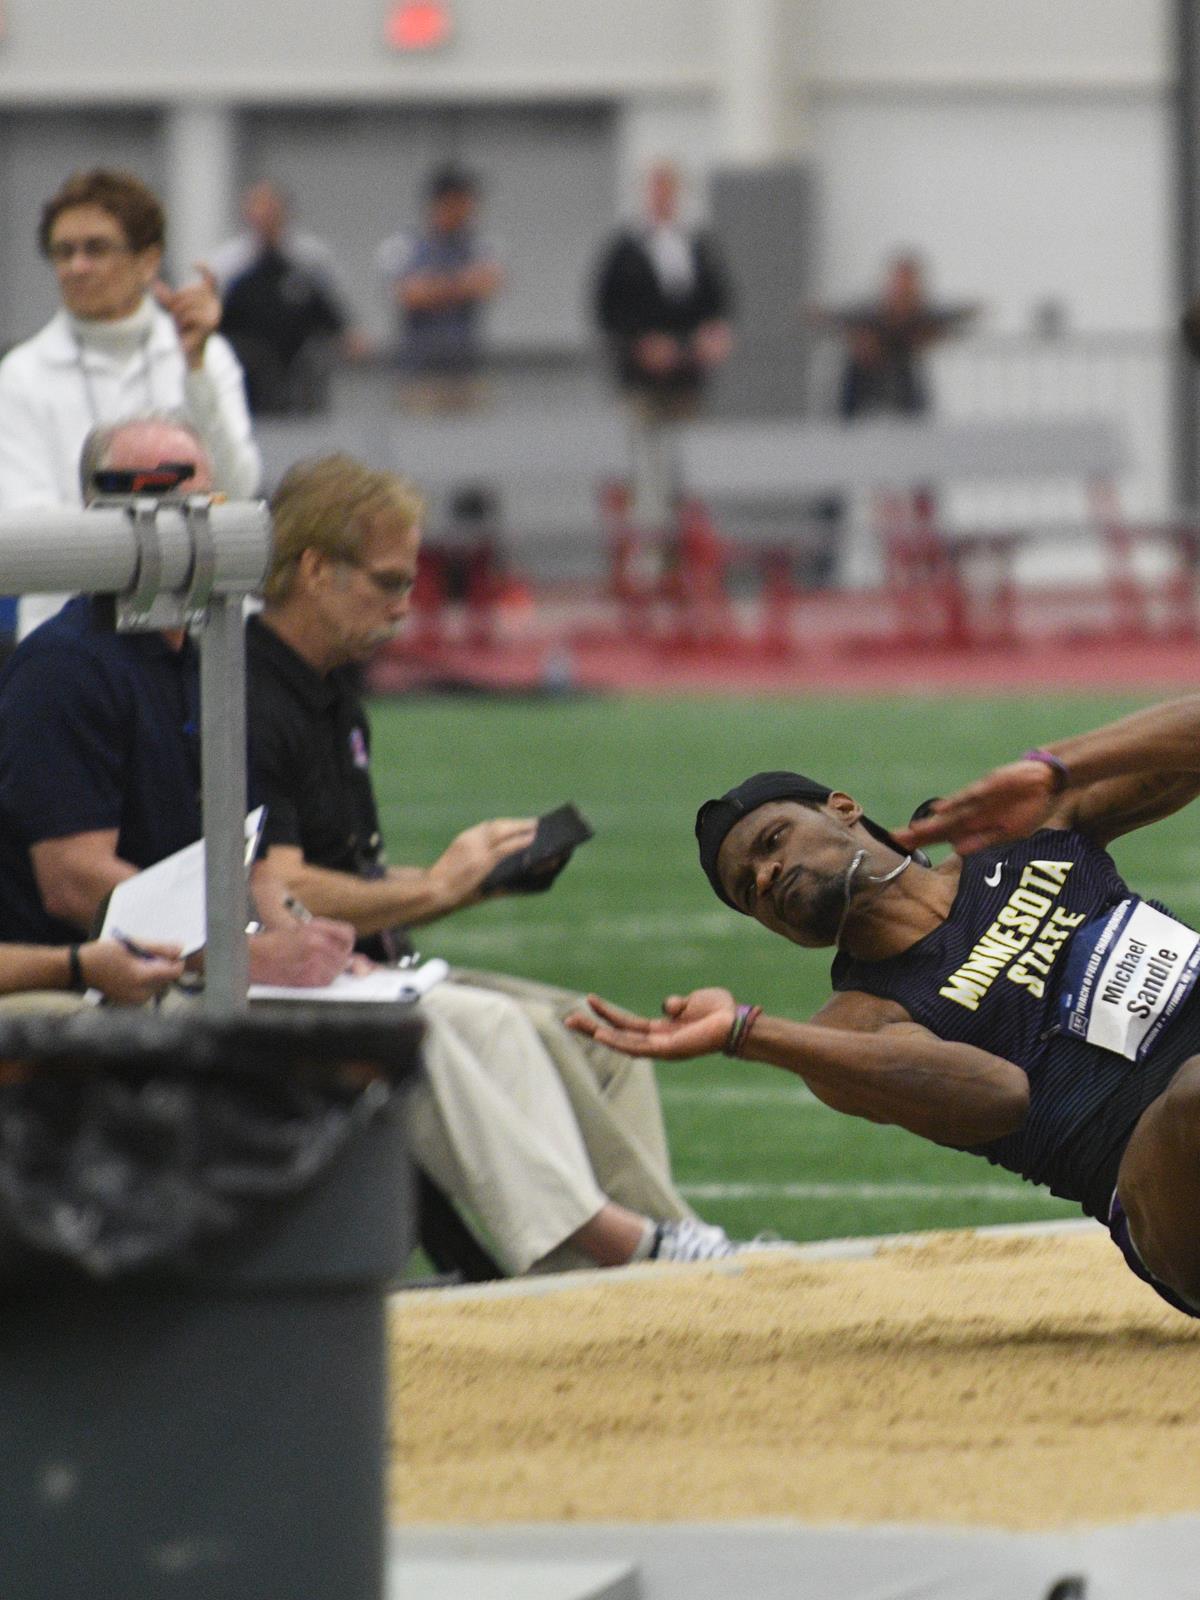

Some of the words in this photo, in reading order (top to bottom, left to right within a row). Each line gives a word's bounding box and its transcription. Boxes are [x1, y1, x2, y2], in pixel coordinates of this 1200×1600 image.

[939, 860, 1074, 1011] MINNESOTA
[1007, 906, 1086, 998] STATE
[1076, 985, 1091, 1014] TRACK
[1085, 953, 1102, 979] FIELD
[1102, 938, 1147, 1005] Michael
[1127, 949, 1178, 1019] Sandle
